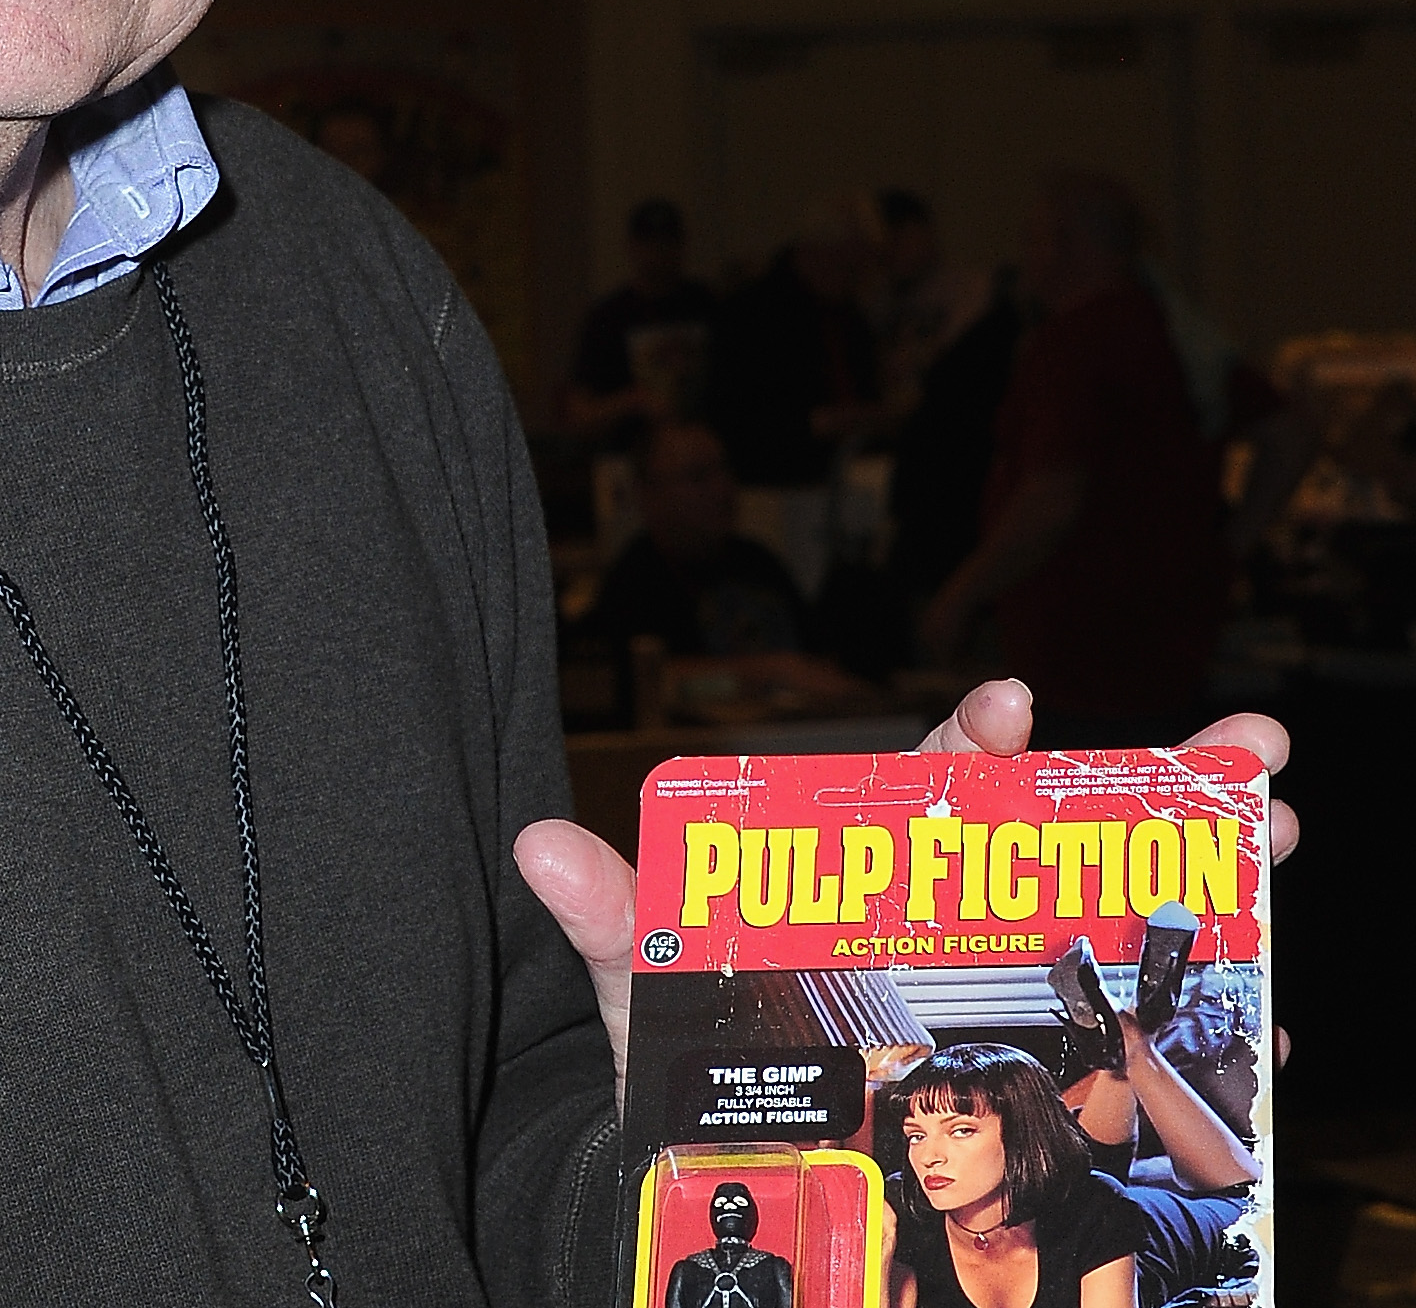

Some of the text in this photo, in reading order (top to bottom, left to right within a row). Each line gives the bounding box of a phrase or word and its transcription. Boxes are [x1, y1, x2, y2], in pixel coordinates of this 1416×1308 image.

[1035, 769, 1064, 777] ADULT
[1137, 766, 1157, 774] NOT
[703, 780, 735, 789] Choking
[1035, 778, 1071, 786] ADULTE
[1158, 775, 1176, 783] PAS
[1178, 775, 1191, 783] UN
[675, 789, 704, 797] contain
[1092, 787, 1105, 795] DE
[1157, 785, 1171, 793] NO
[680, 816, 1239, 927] PULP FICTION
[649, 935, 675, 947] AGE
[832, 934, 1045, 956] ACTION FIGURE
[649, 946, 675, 960] 17+
[708, 1066, 823, 1084] THE GIMP
[735, 1085, 743, 1096] 3
[765, 1085, 795, 1096] INCH
[717, 1096, 812, 1109] FULLY POSABLE
[699, 1110, 828, 1125] ACTION FIGURE
